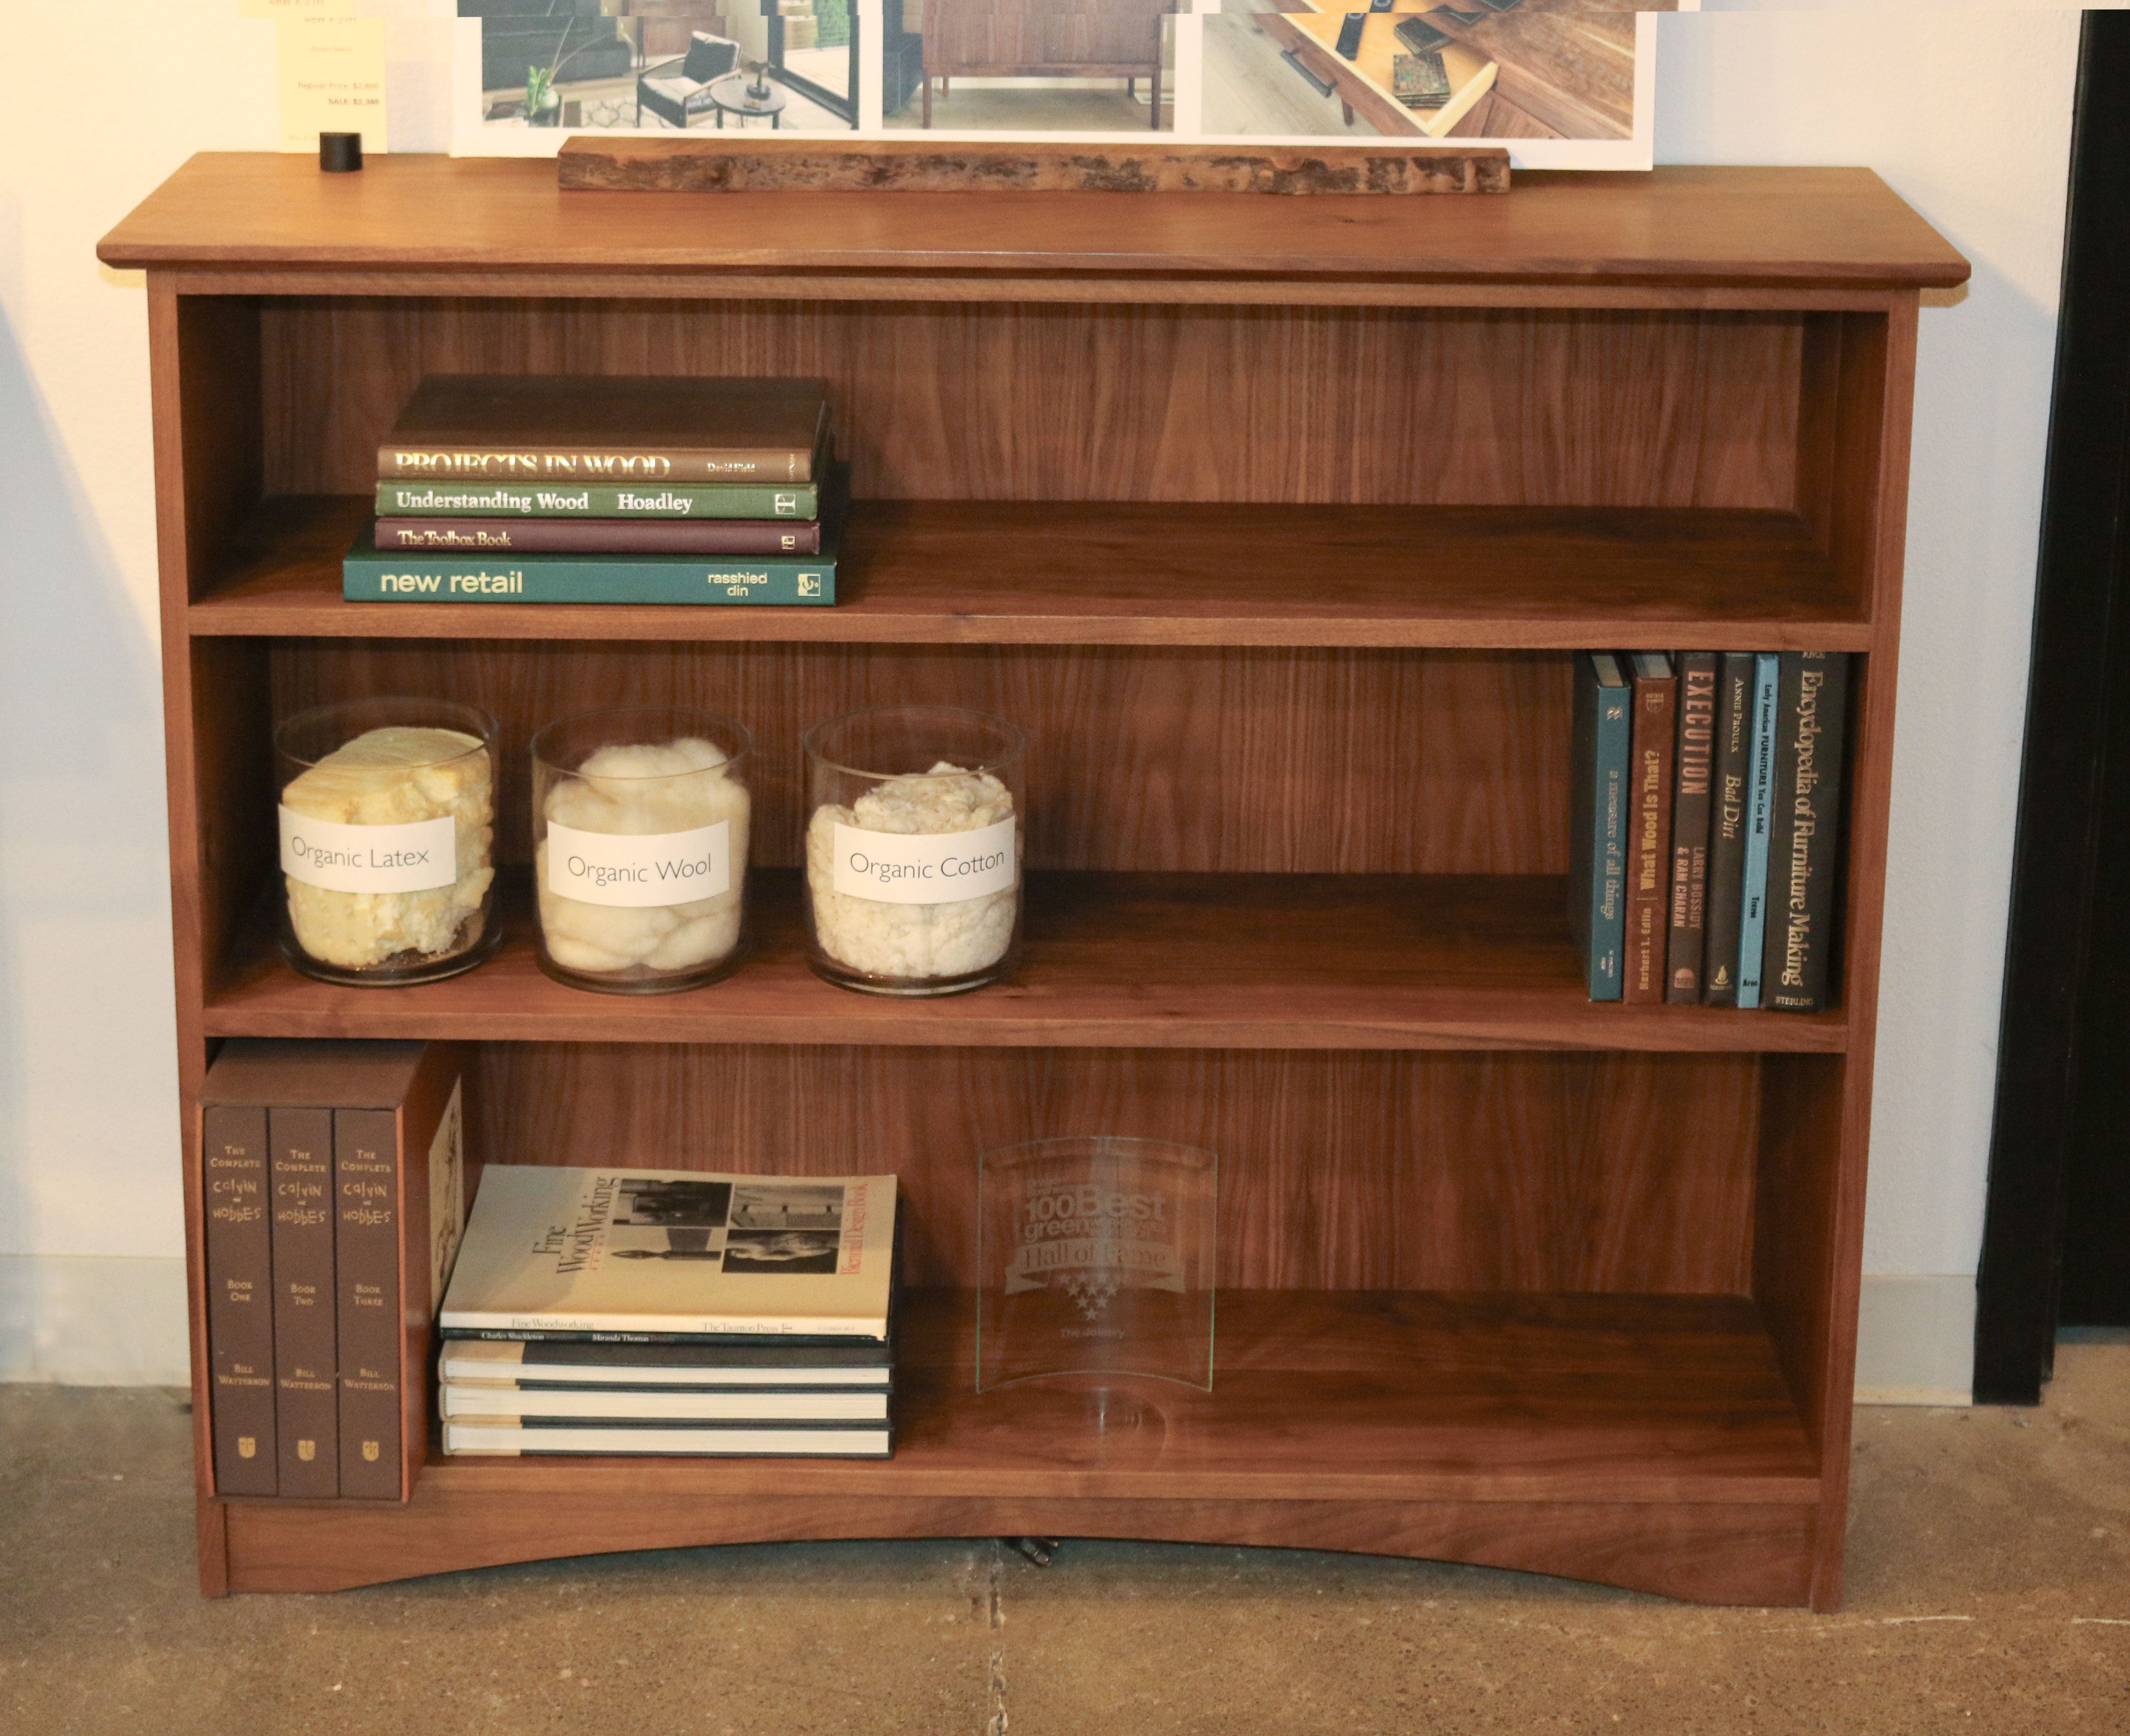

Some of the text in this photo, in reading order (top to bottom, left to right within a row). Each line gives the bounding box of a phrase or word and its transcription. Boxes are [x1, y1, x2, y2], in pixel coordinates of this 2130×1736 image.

[395, 453, 671, 476] PROJECTS IN WOOD
[396, 491, 693, 514] Understanding Wood Hoadley
[397, 530, 512, 546] The Toolbox Book
[381, 571, 523, 593] new retail
[708, 572, 768, 584] rasshied
[727, 585, 749, 597] din
[1763, 683, 1773, 700] Early
[1731, 677, 1745, 753] ANNIE PROULX
[1762, 703, 1772, 733] American
[1681, 671, 1714, 795] EXECUTION
[1758, 735, 1770, 786] FURNITURE
[1758, 788, 1766, 801] You
[1722, 774, 1742, 839] Bad Dirt
[1640, 749, 1660, 891] What Wood Is That?
[1781, 670, 1824, 987] Encyclopedia of Furniture Making
[292, 836, 430, 868] Organic Latex
[1600, 771, 1621, 920] a measure of all things
[568, 853, 711, 887] Organic Wool
[850, 851, 1005, 883] Organic Cotton
[1673, 847, 1689, 928] & RAM CHARAN
[1688, 846, 1705, 929] LARRY BOSSIDY
[1641, 907, 1652, 934] Edlin
[1639, 949, 1651, 990] Herbert
[225, 1146, 245, 1156] THE
[289, 1149, 311, 1160] THE
[356, 1150, 376, 1160] THE
[210, 1158, 261, 1168] COMPLETE
[275, 1161, 327, 1173] COMPLETE
[341, 1161, 392, 1173] COMPLETE
[532, 1226, 567, 1254] Fine
[1025, 1242, 1069, 1268] Hall
[511, 1318, 531, 1328] Fine
[702, 1322, 719, 1332] The
[721, 1322, 755, 1333] Taunton
[756, 1323, 779, 1333] Press
[480, 1332, 507, 1340] Charles
[508, 1333, 545, 1341] Shackleton
[622, 1334, 649, 1342] Thomas
